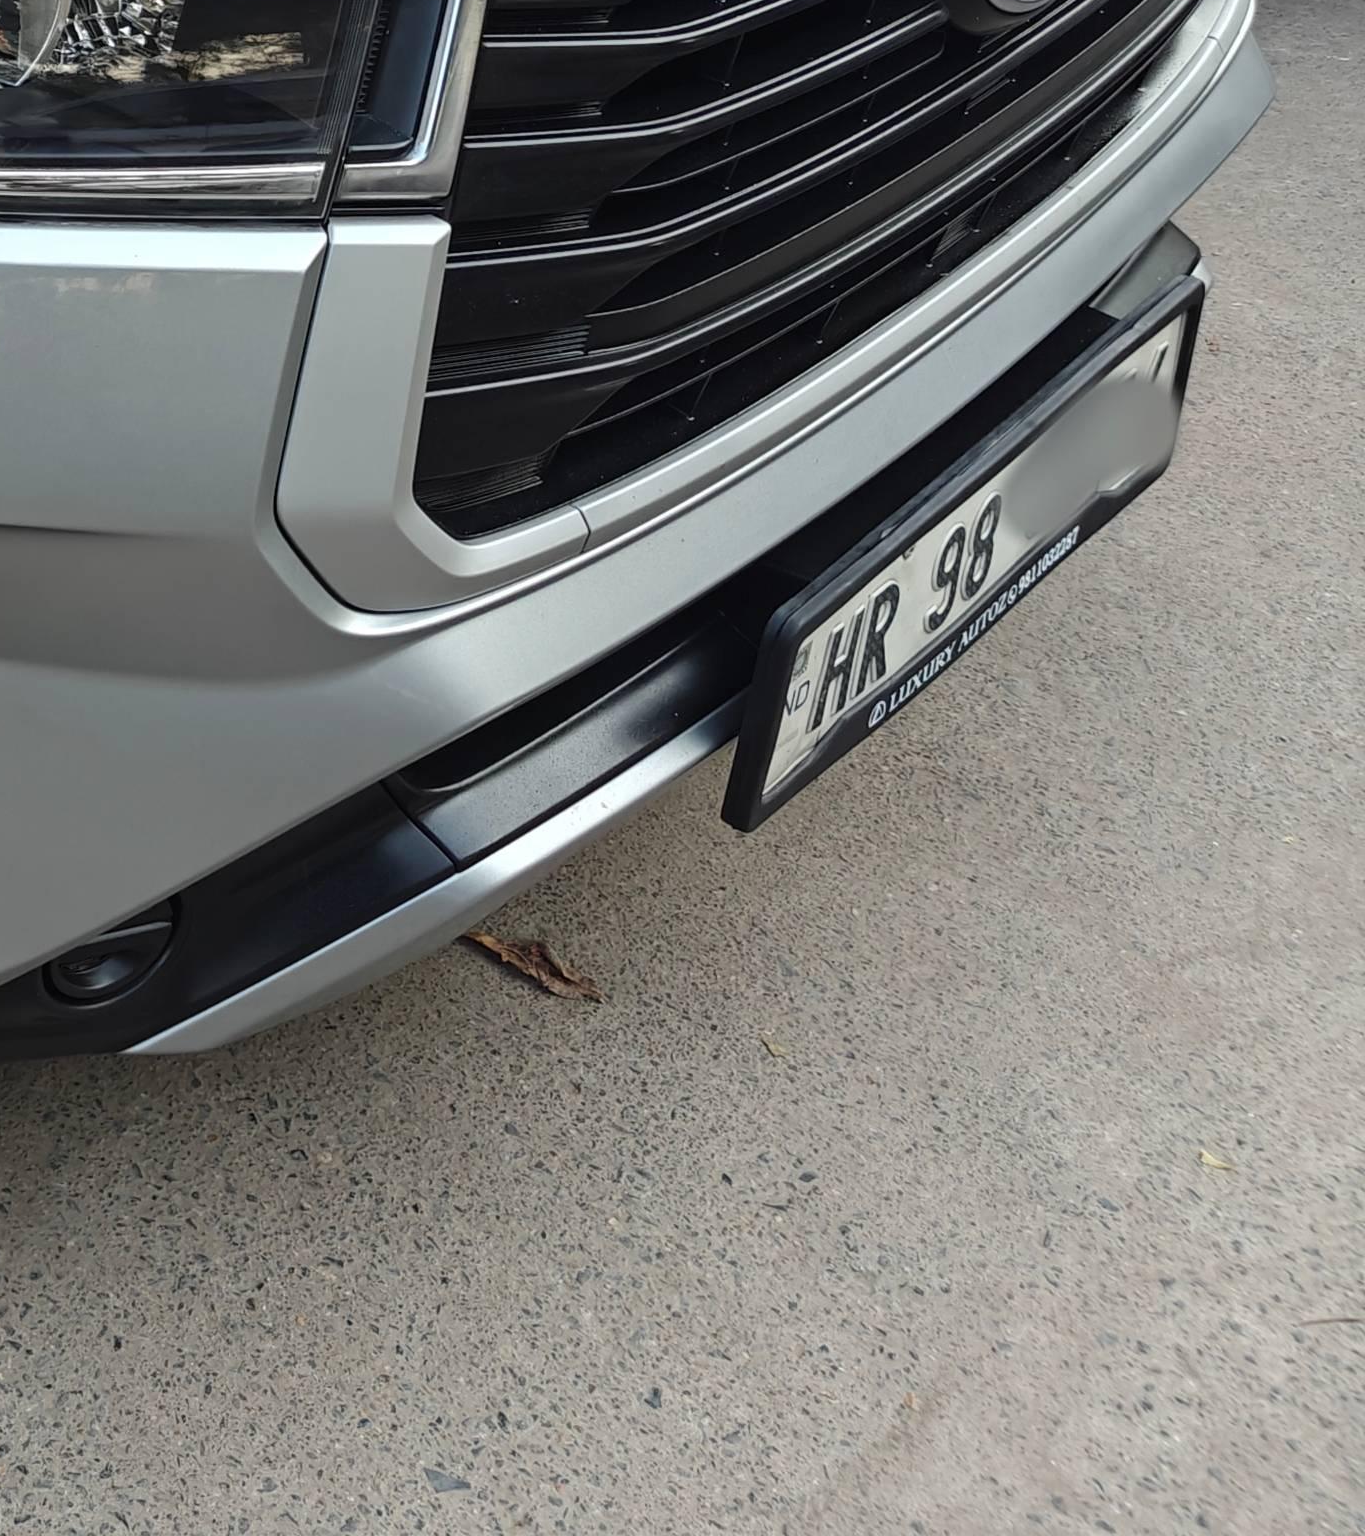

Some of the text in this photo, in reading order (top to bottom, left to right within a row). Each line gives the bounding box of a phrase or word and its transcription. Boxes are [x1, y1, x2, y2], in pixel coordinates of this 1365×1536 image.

[806, 490, 1002, 734] HR 98
[889, 639, 958, 711] LUXURY
[957, 596, 1008, 653] AUTOZ
[785, 680, 810, 716] ND
